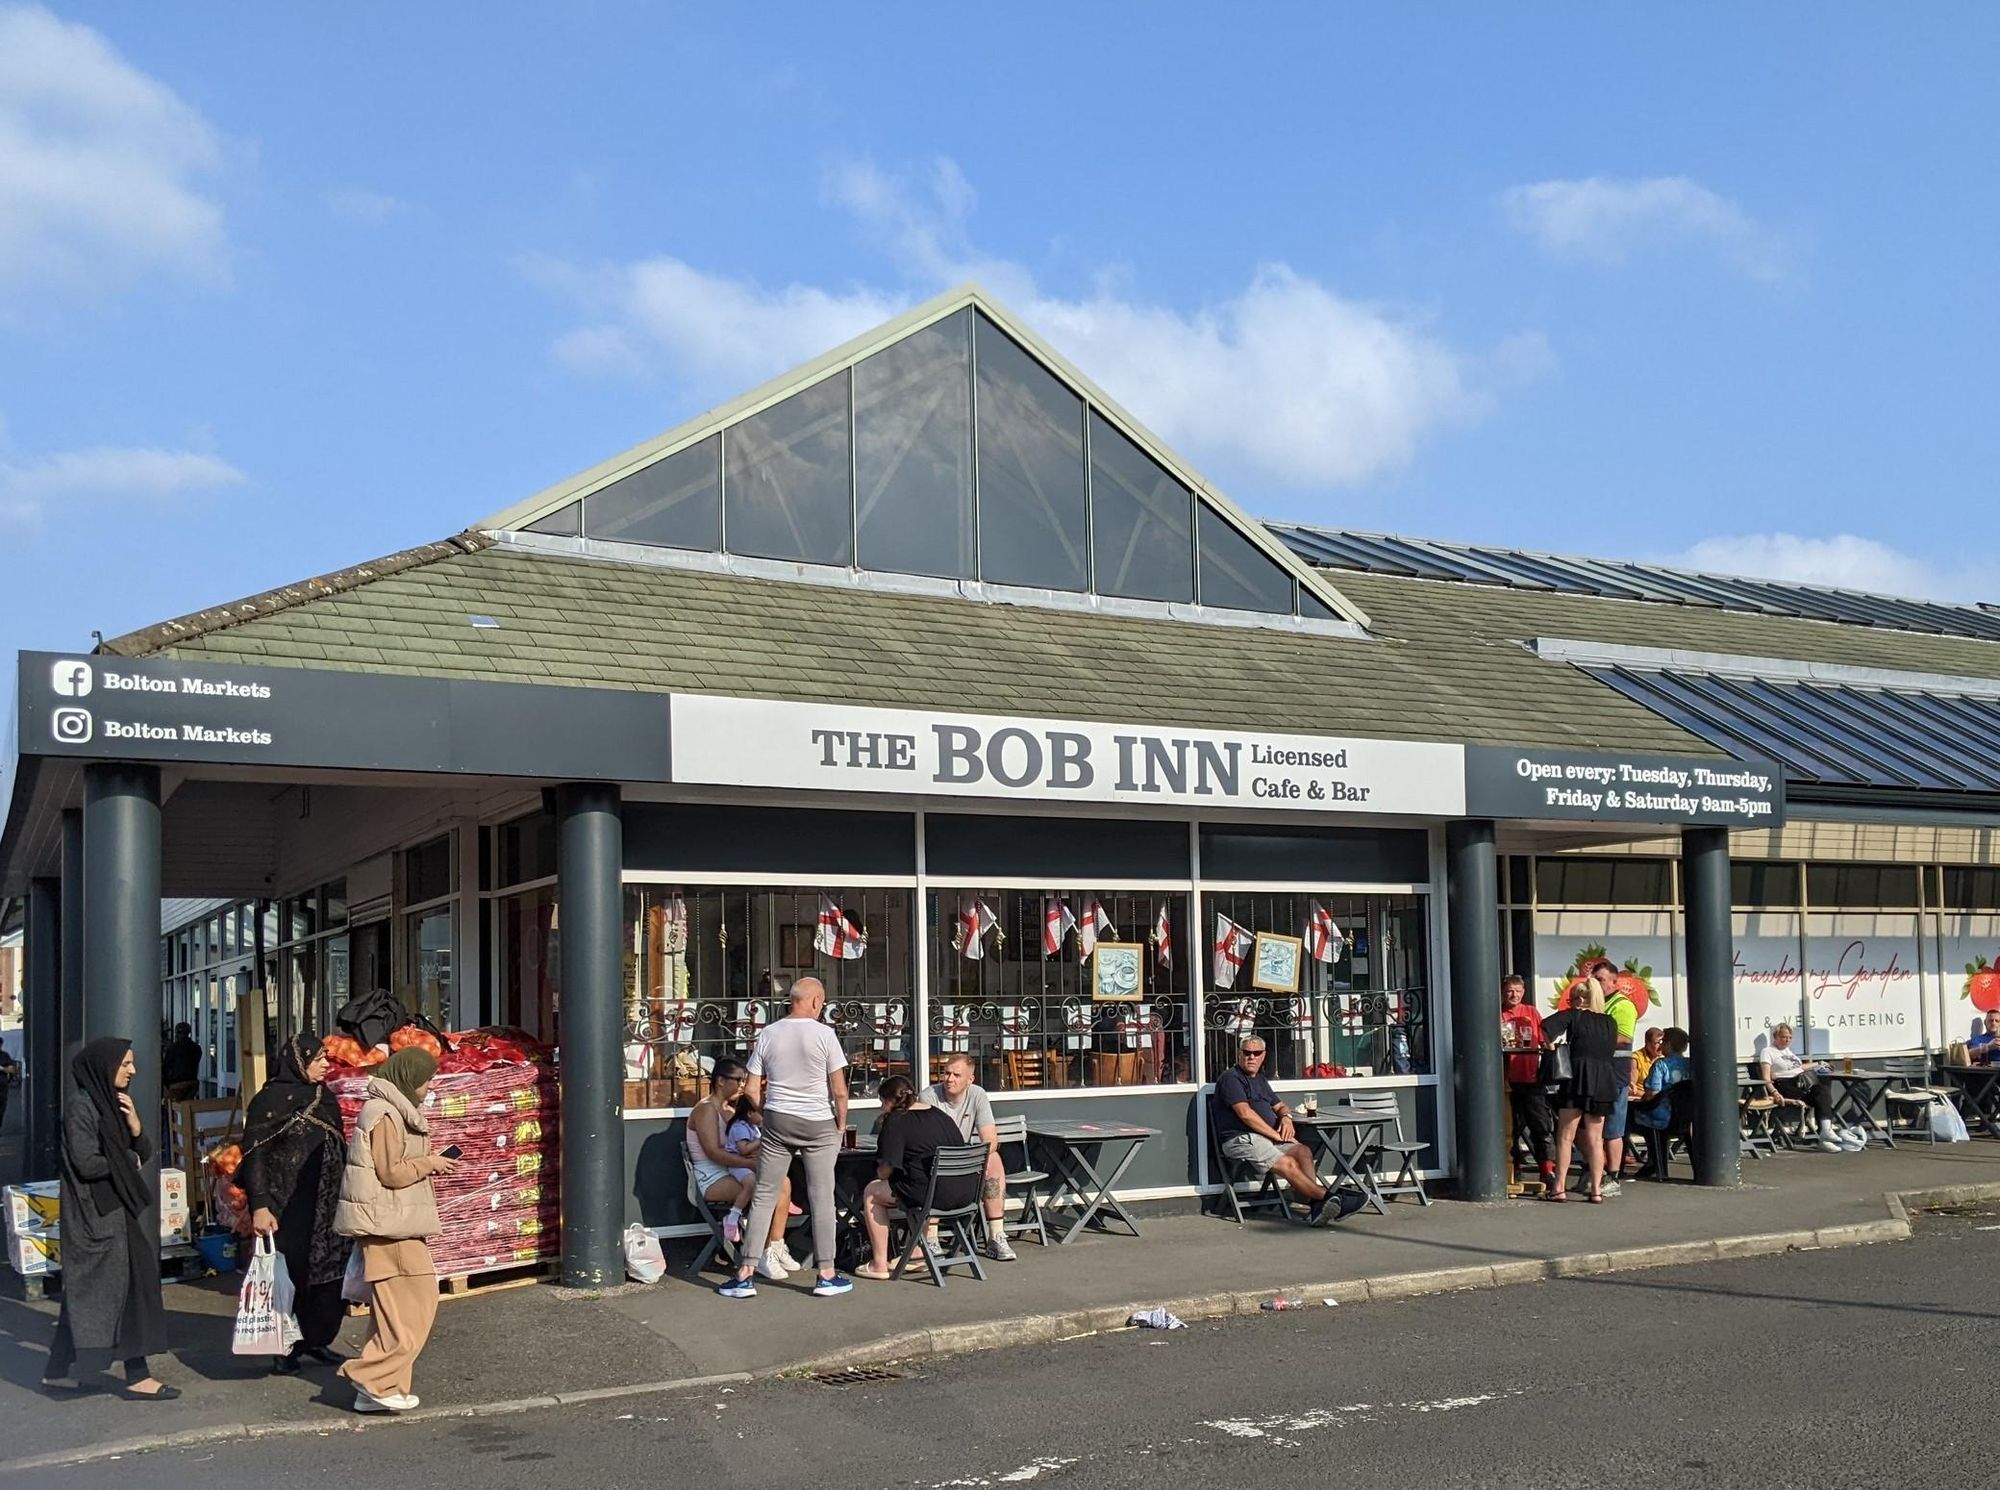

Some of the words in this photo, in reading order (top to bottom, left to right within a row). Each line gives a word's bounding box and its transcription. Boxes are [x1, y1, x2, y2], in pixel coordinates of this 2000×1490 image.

[103, 672, 177, 693] Bolton
[182, 677, 271, 699] Markets
[104, 720, 178, 741] Bolton
[182, 725, 272, 745] Markets
[811, 729, 917, 772] THE
[931, 724, 1095, 790] BOB
[1113, 735, 1242, 797] INN
[1251, 744, 1348, 769] Licensed
[1516, 758, 1562, 781] Open
[1566, 766, 1616, 785] every:
[1619, 764, 1693, 788] Tuesday,
[1694, 768, 1773, 792] Thursday,
[1251, 777, 1303, 800] Cafe
[1306, 781, 1327, 801] &
[1331, 781, 1371, 802] Bar
[1546, 788, 1602, 811] Friday
[1606, 791, 1621, 808] &
[1624, 791, 1699, 815] Saturday
[1701, 796, 1773, 818] 9am-5pm
[1733, 950, 1843, 1000] trawberry
[1838, 940, 1913, 1001] Garden
[1827, 1012, 1906, 1027] CATERING
